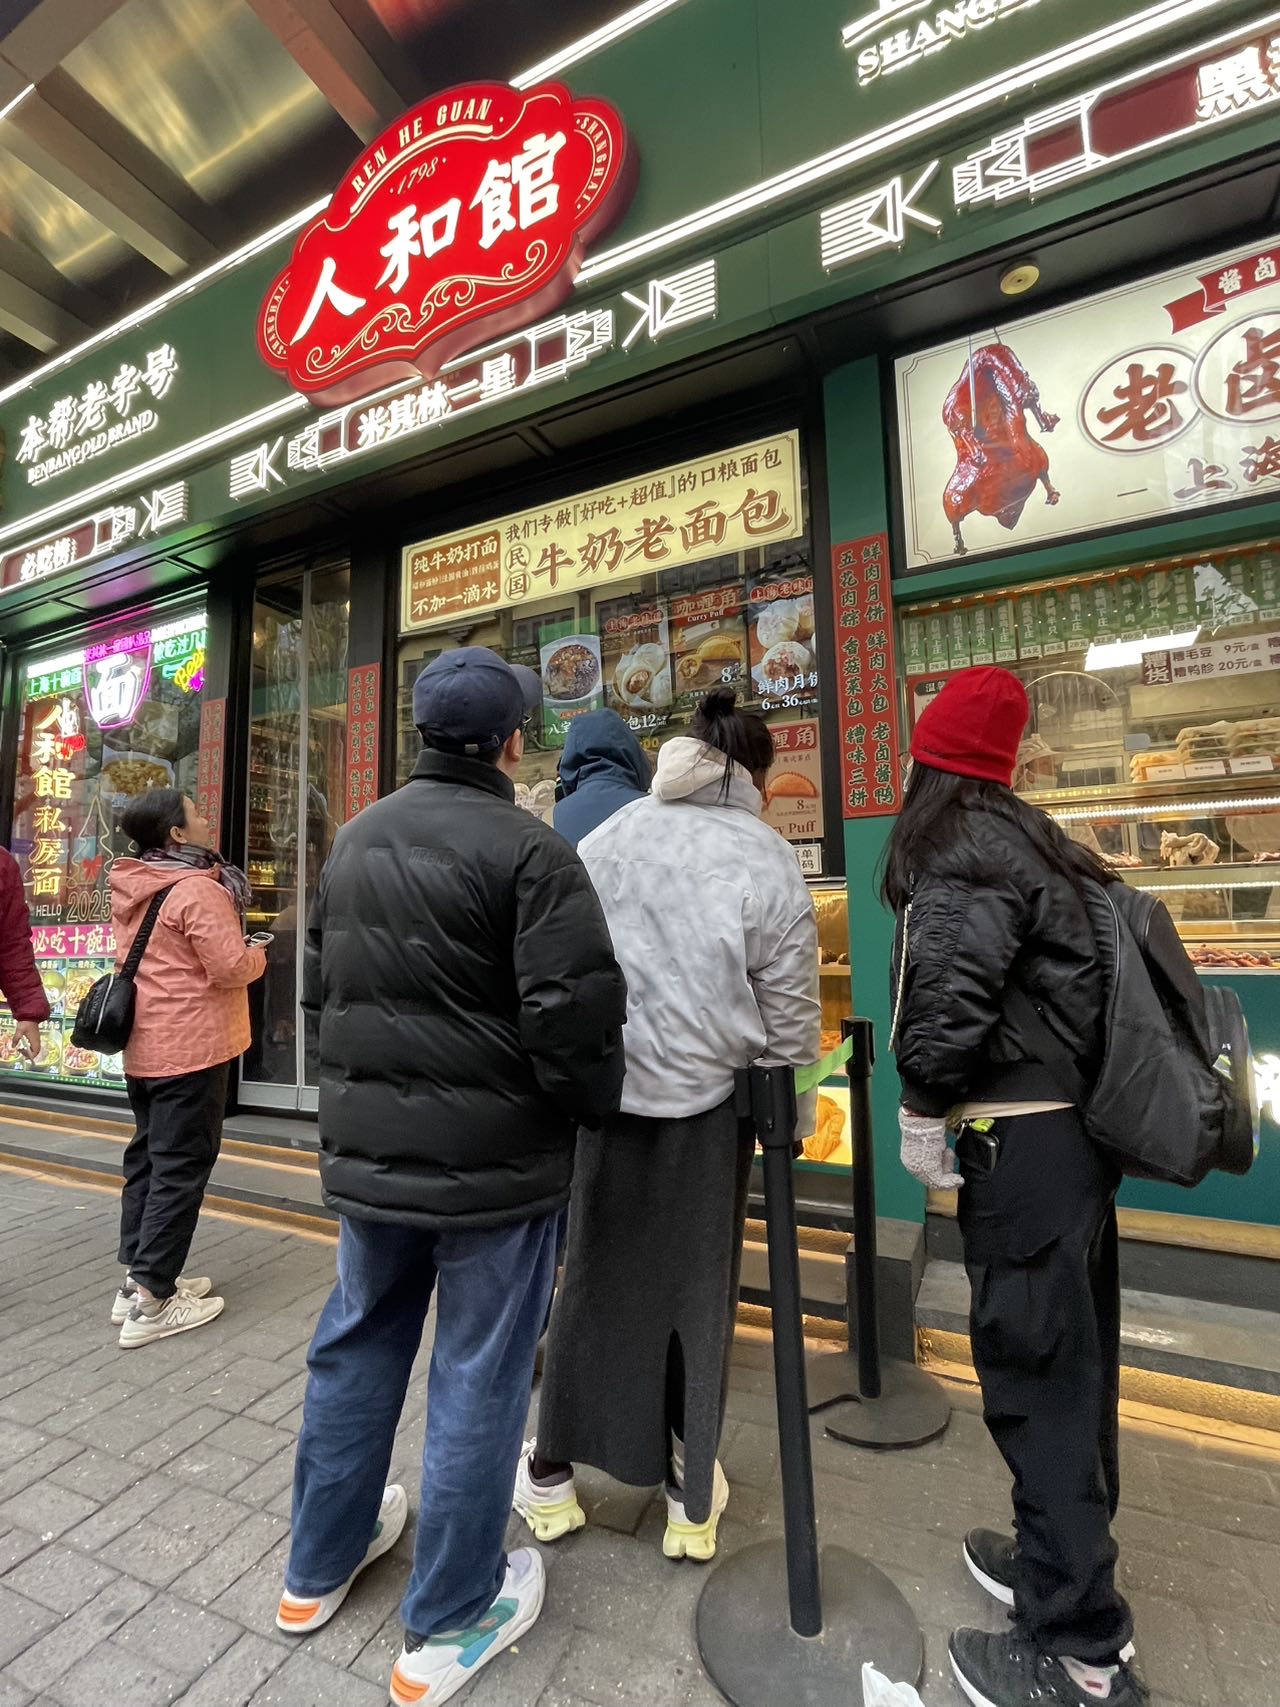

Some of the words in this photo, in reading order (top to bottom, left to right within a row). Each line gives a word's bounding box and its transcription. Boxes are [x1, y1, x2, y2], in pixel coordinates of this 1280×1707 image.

[857, 0, 1045, 86] SHANG
[1195, 38, 1280, 119] 黑
[351, 146, 388, 194] REN
[398, 117, 423, 148] HE
[436, 98, 492, 126] GUAN
[397, 157, 439, 195] 1798
[580, 117, 608, 202] SHANGHAI
[289, 131, 567, 346] 人和館
[267, 285, 285, 355] SHANGHAI
[16, 343, 178, 463] 本帮老字号
[108, 410, 158, 446] BRAND
[357, 353, 515, 447] 米其林一星
[413, 536, 498, 575] 纯牛奶打面
[507, 546, 528, 597] 民国
[531, 487, 792, 588] 牛奶老面包
[412, 581, 499, 616] 不加一滴水
[687, 613, 708, 622] Curry
[838, 550, 860, 628] 五花肉粽
[862, 543, 885, 623] 鲜肉月饼
[721, 667, 732, 683] 8
[762, 698, 771, 711] 6
[782, 694, 799, 708] 36
[842, 636, 863, 717] 香菇菜包
[866, 630, 889, 713] 鲜肉大包
[846, 726, 868, 806] 糟味三拼
[871, 722, 895, 805] 老卤酱鸭
[789, 820, 816, 834] Puff
[36, 903, 62, 917] HELLO
[66, 889, 113, 923] 2025
[166, 1306, 191, 1326] N
